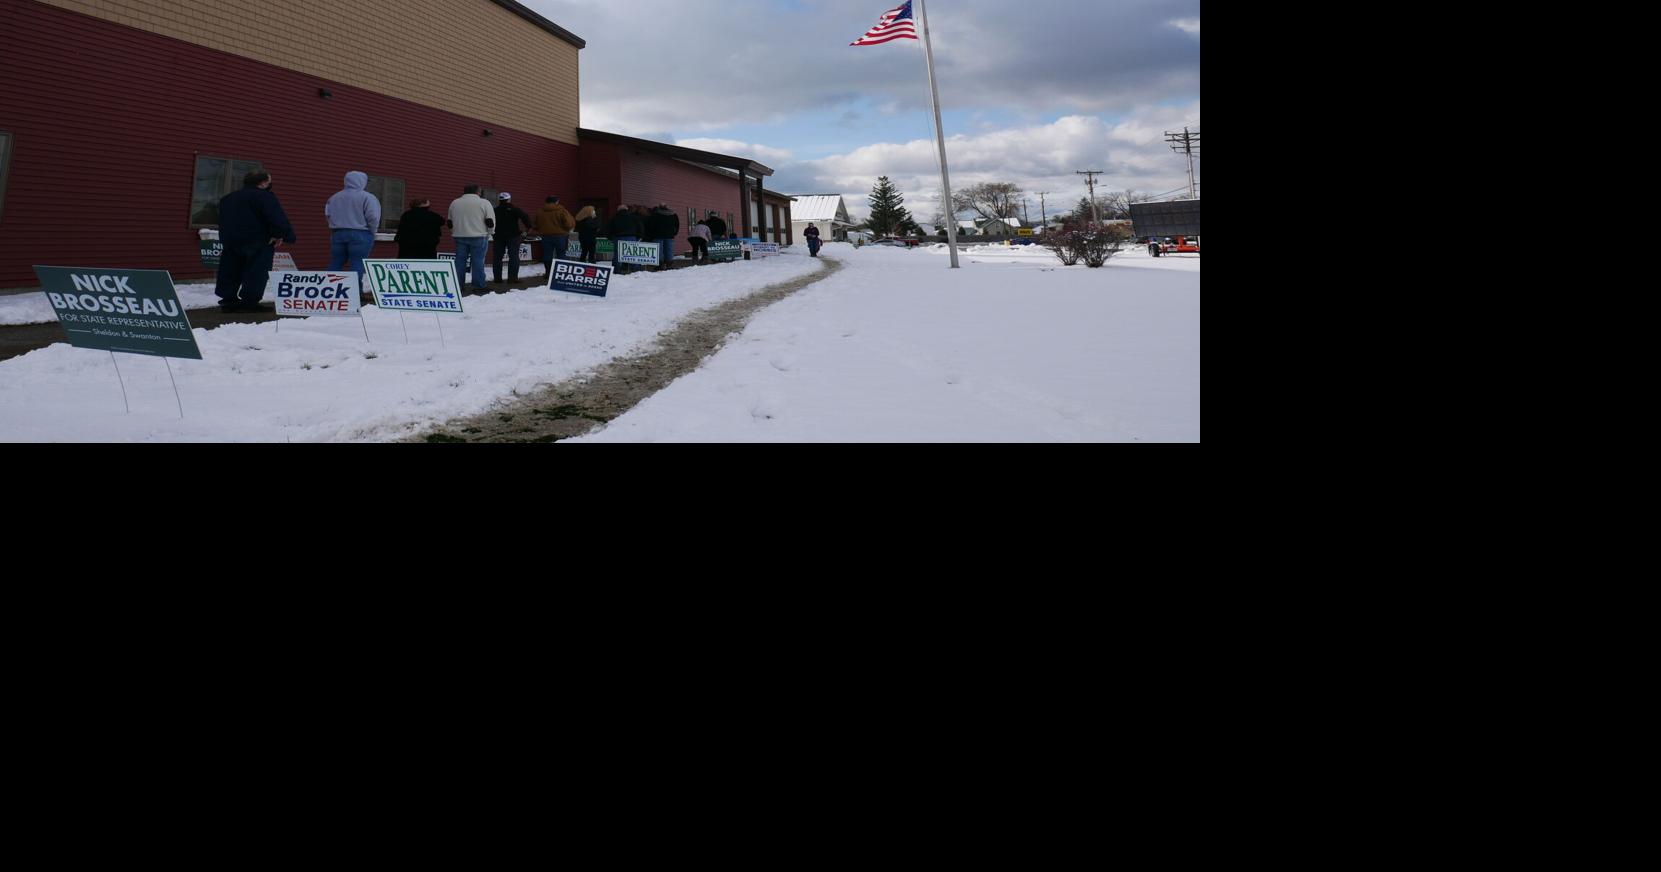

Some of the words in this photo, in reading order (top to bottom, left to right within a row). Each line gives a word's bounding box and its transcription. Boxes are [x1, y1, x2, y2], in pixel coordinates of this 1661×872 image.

[622, 242, 656, 258] PARENT
[282, 273, 326, 285] Randy
[372, 263, 449, 295] PARENT
[555, 272, 607, 286] HARRIS
[556, 263, 608, 279] BIDEN
[70, 273, 136, 294] NICK
[277, 282, 352, 299] Brock
[48, 292, 179, 317] BROSSEAU
[283, 299, 349, 311] SENATE
[381, 299, 413, 307] STATE
[416, 300, 457, 309] SENATE
[59, 313, 80, 322] FOR
[82, 314, 106, 324] STATE
[107, 317, 186, 330] REPRESENTATIVE
[91, 328, 121, 338] Sheldon
[129, 331, 162, 341] Swanton
